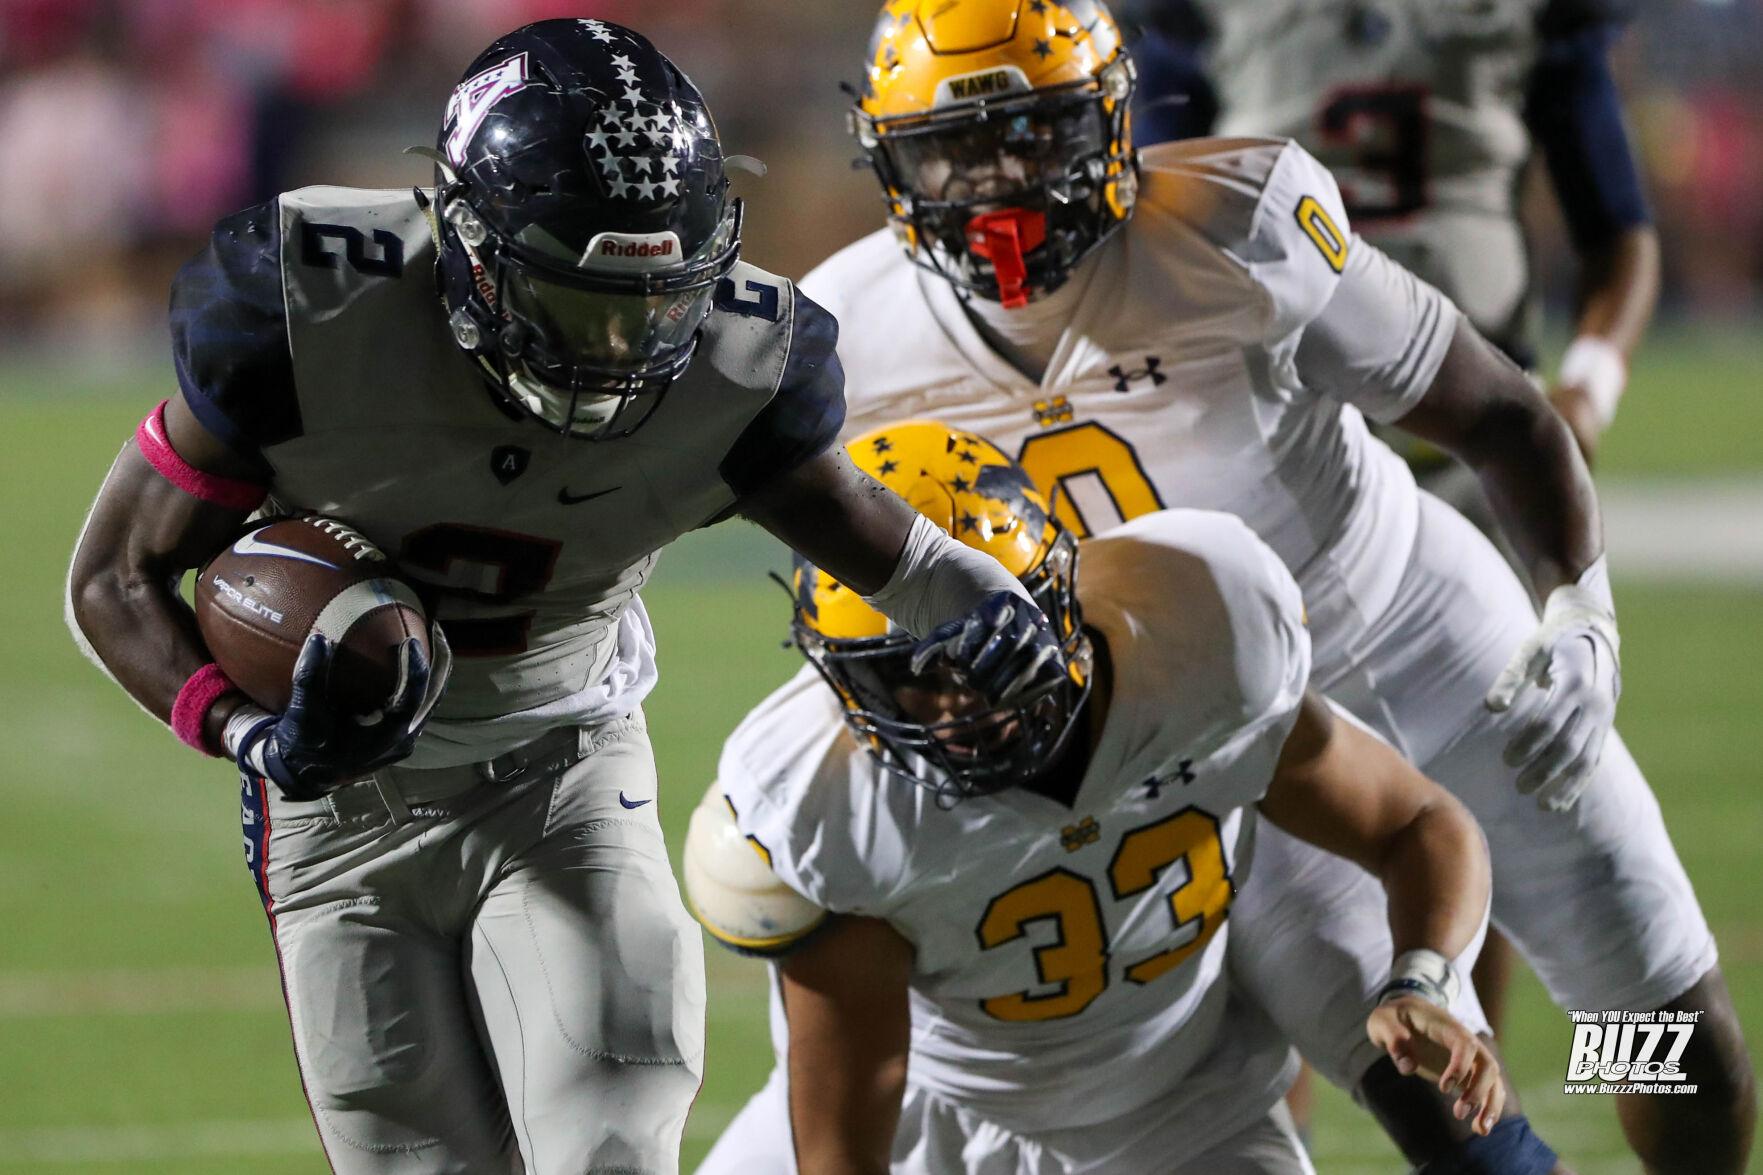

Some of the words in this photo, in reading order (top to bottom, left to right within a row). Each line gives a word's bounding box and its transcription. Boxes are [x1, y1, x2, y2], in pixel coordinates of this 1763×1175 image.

[1315, 80, 1435, 232] 3
[301, 222, 404, 278] 2
[601, 239, 673, 257] Riddell
[1294, 195, 1349, 275] 0
[213, 574, 243, 603] VAPOR
[242, 597, 283, 624] ELITE
[402, 522, 564, 657] 2
[975, 804, 1236, 1022] 33
